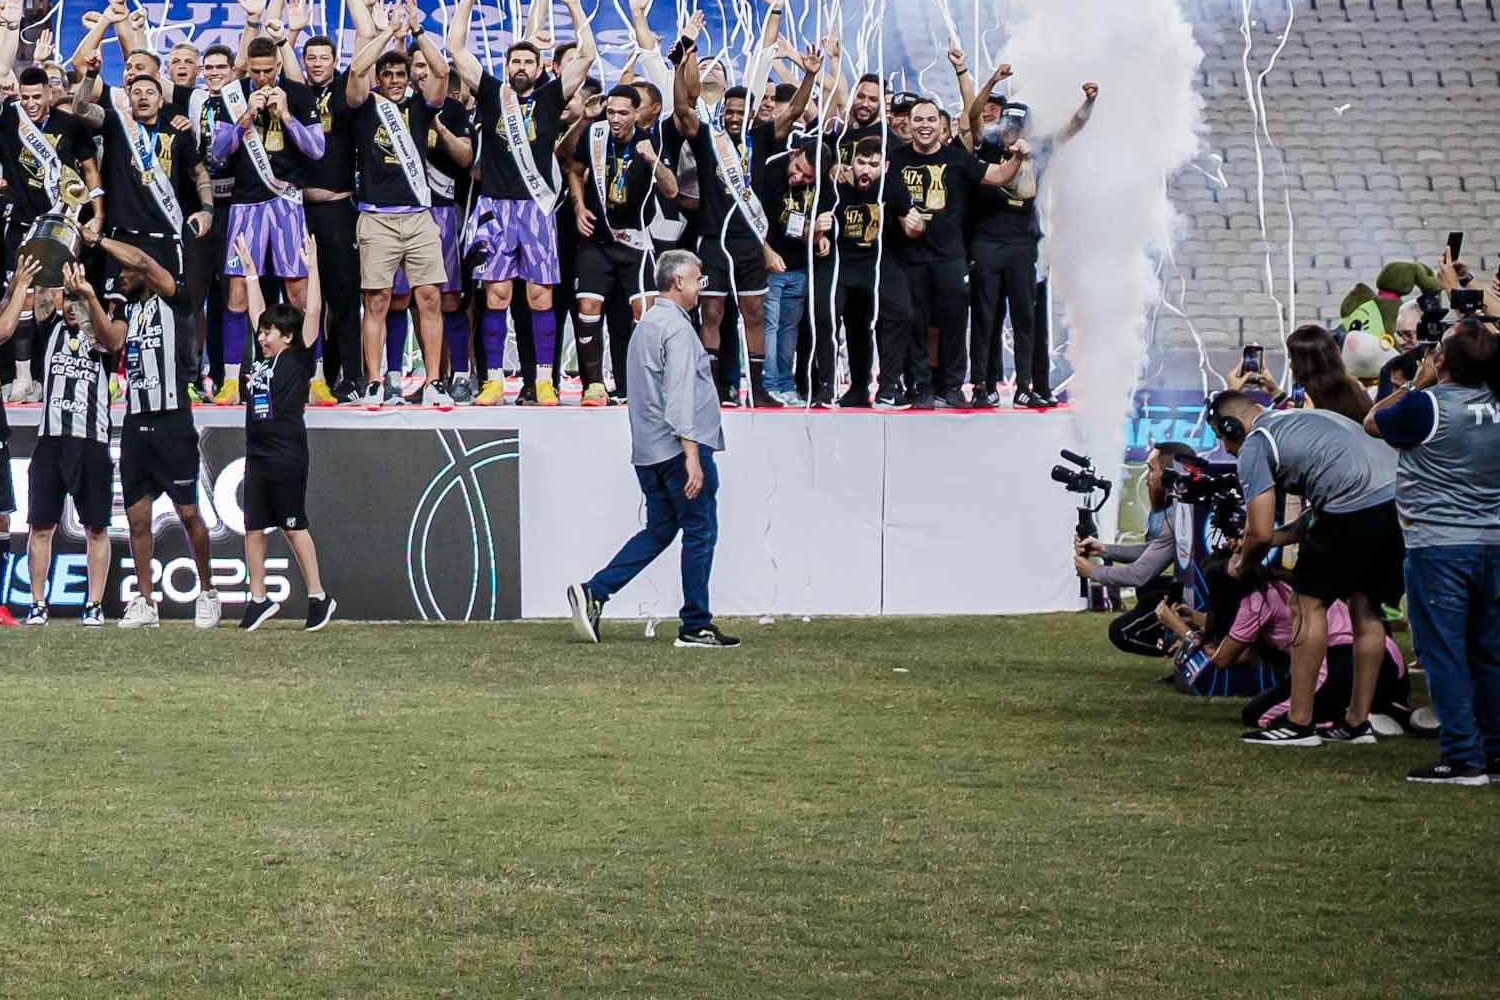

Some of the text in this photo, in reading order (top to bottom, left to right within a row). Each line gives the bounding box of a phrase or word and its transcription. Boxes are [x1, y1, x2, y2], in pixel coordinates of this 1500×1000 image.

[379, 102, 401, 134] CEARENSE
[903, 169, 923, 185] 47x
[845, 209, 864, 225] 47x
[119, 556, 292, 603] 2025
